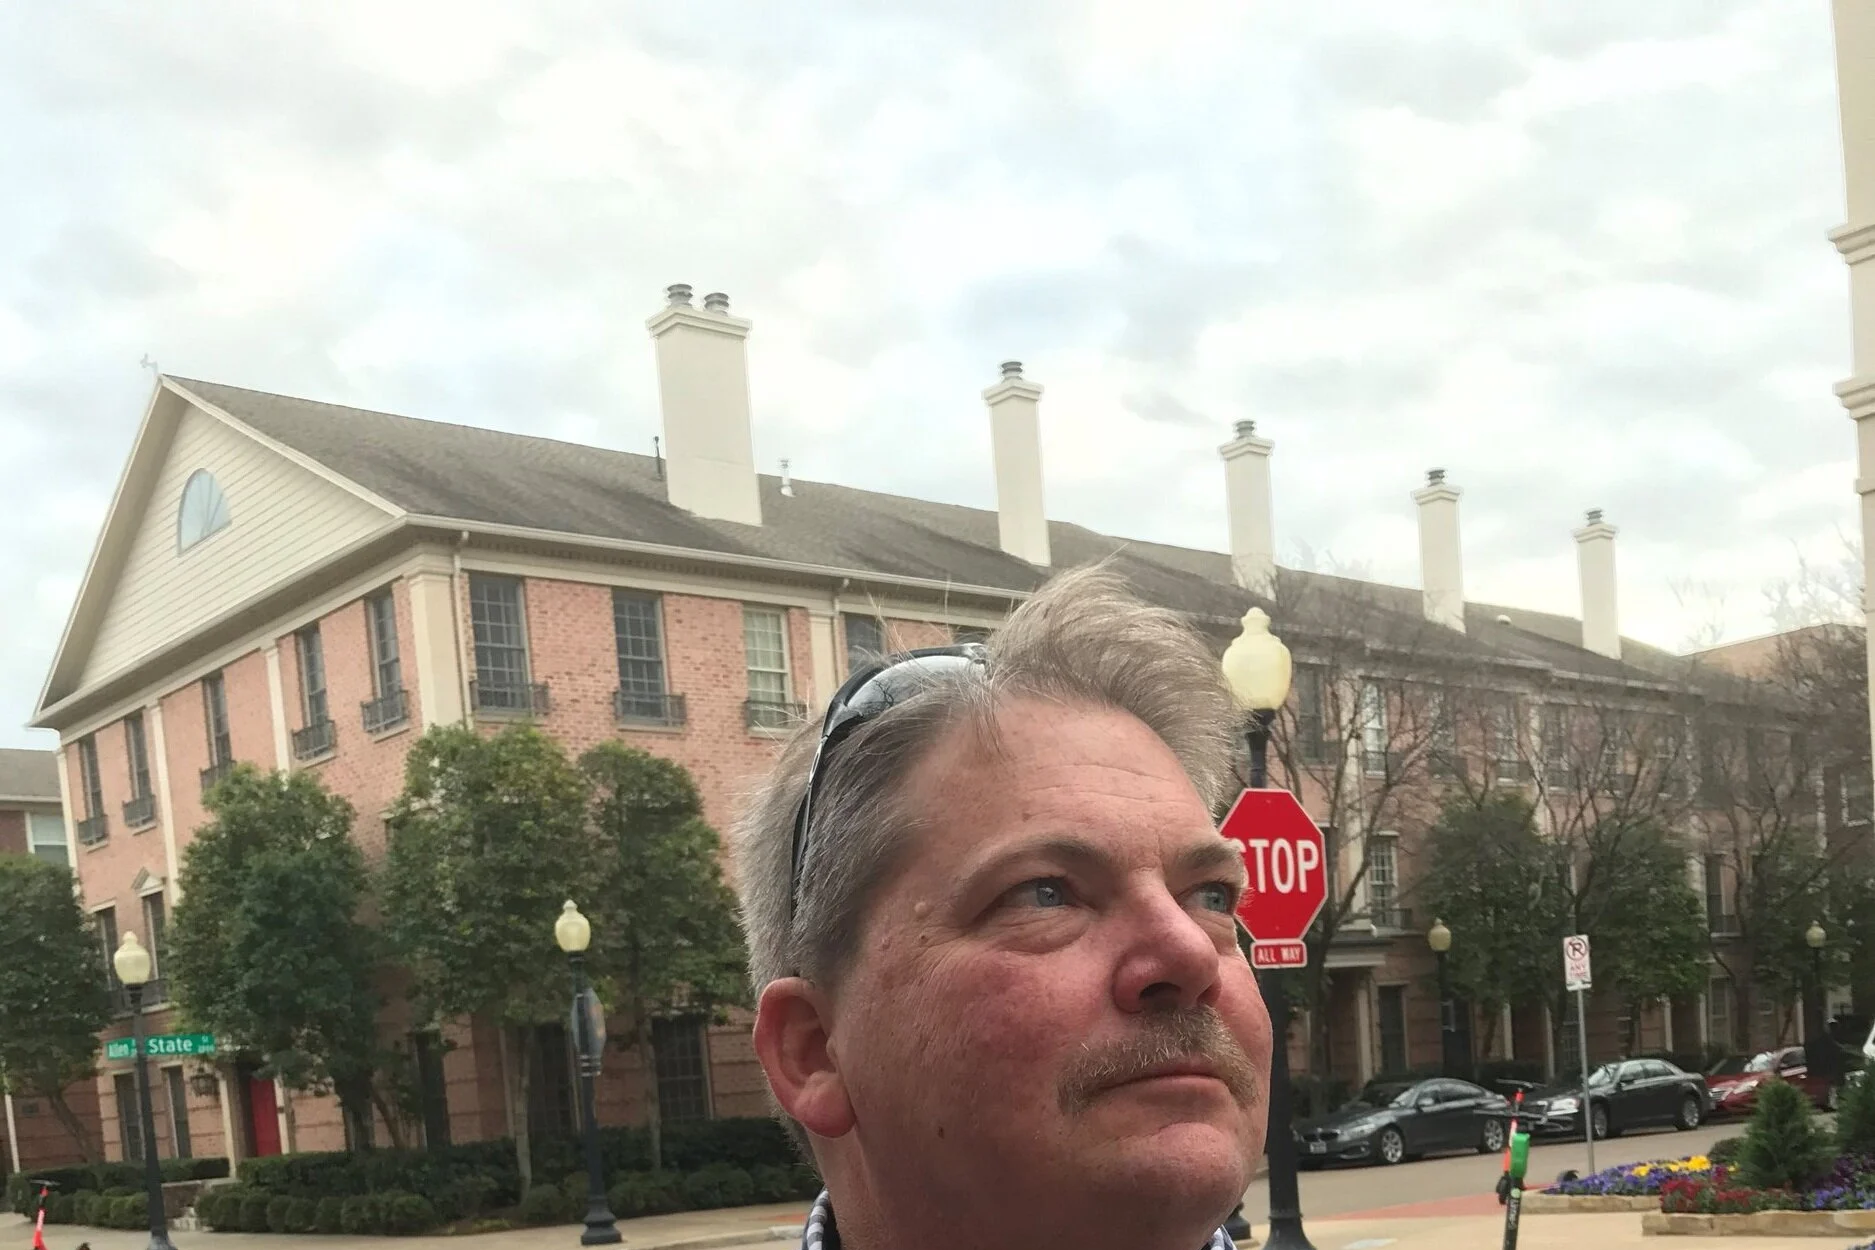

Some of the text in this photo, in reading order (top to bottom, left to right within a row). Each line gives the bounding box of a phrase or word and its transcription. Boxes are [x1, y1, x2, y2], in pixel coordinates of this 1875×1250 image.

[1232, 838, 1319, 893] TOP
[1257, 946, 1300, 962] ALL WAY
[148, 1038, 193, 1053] State
